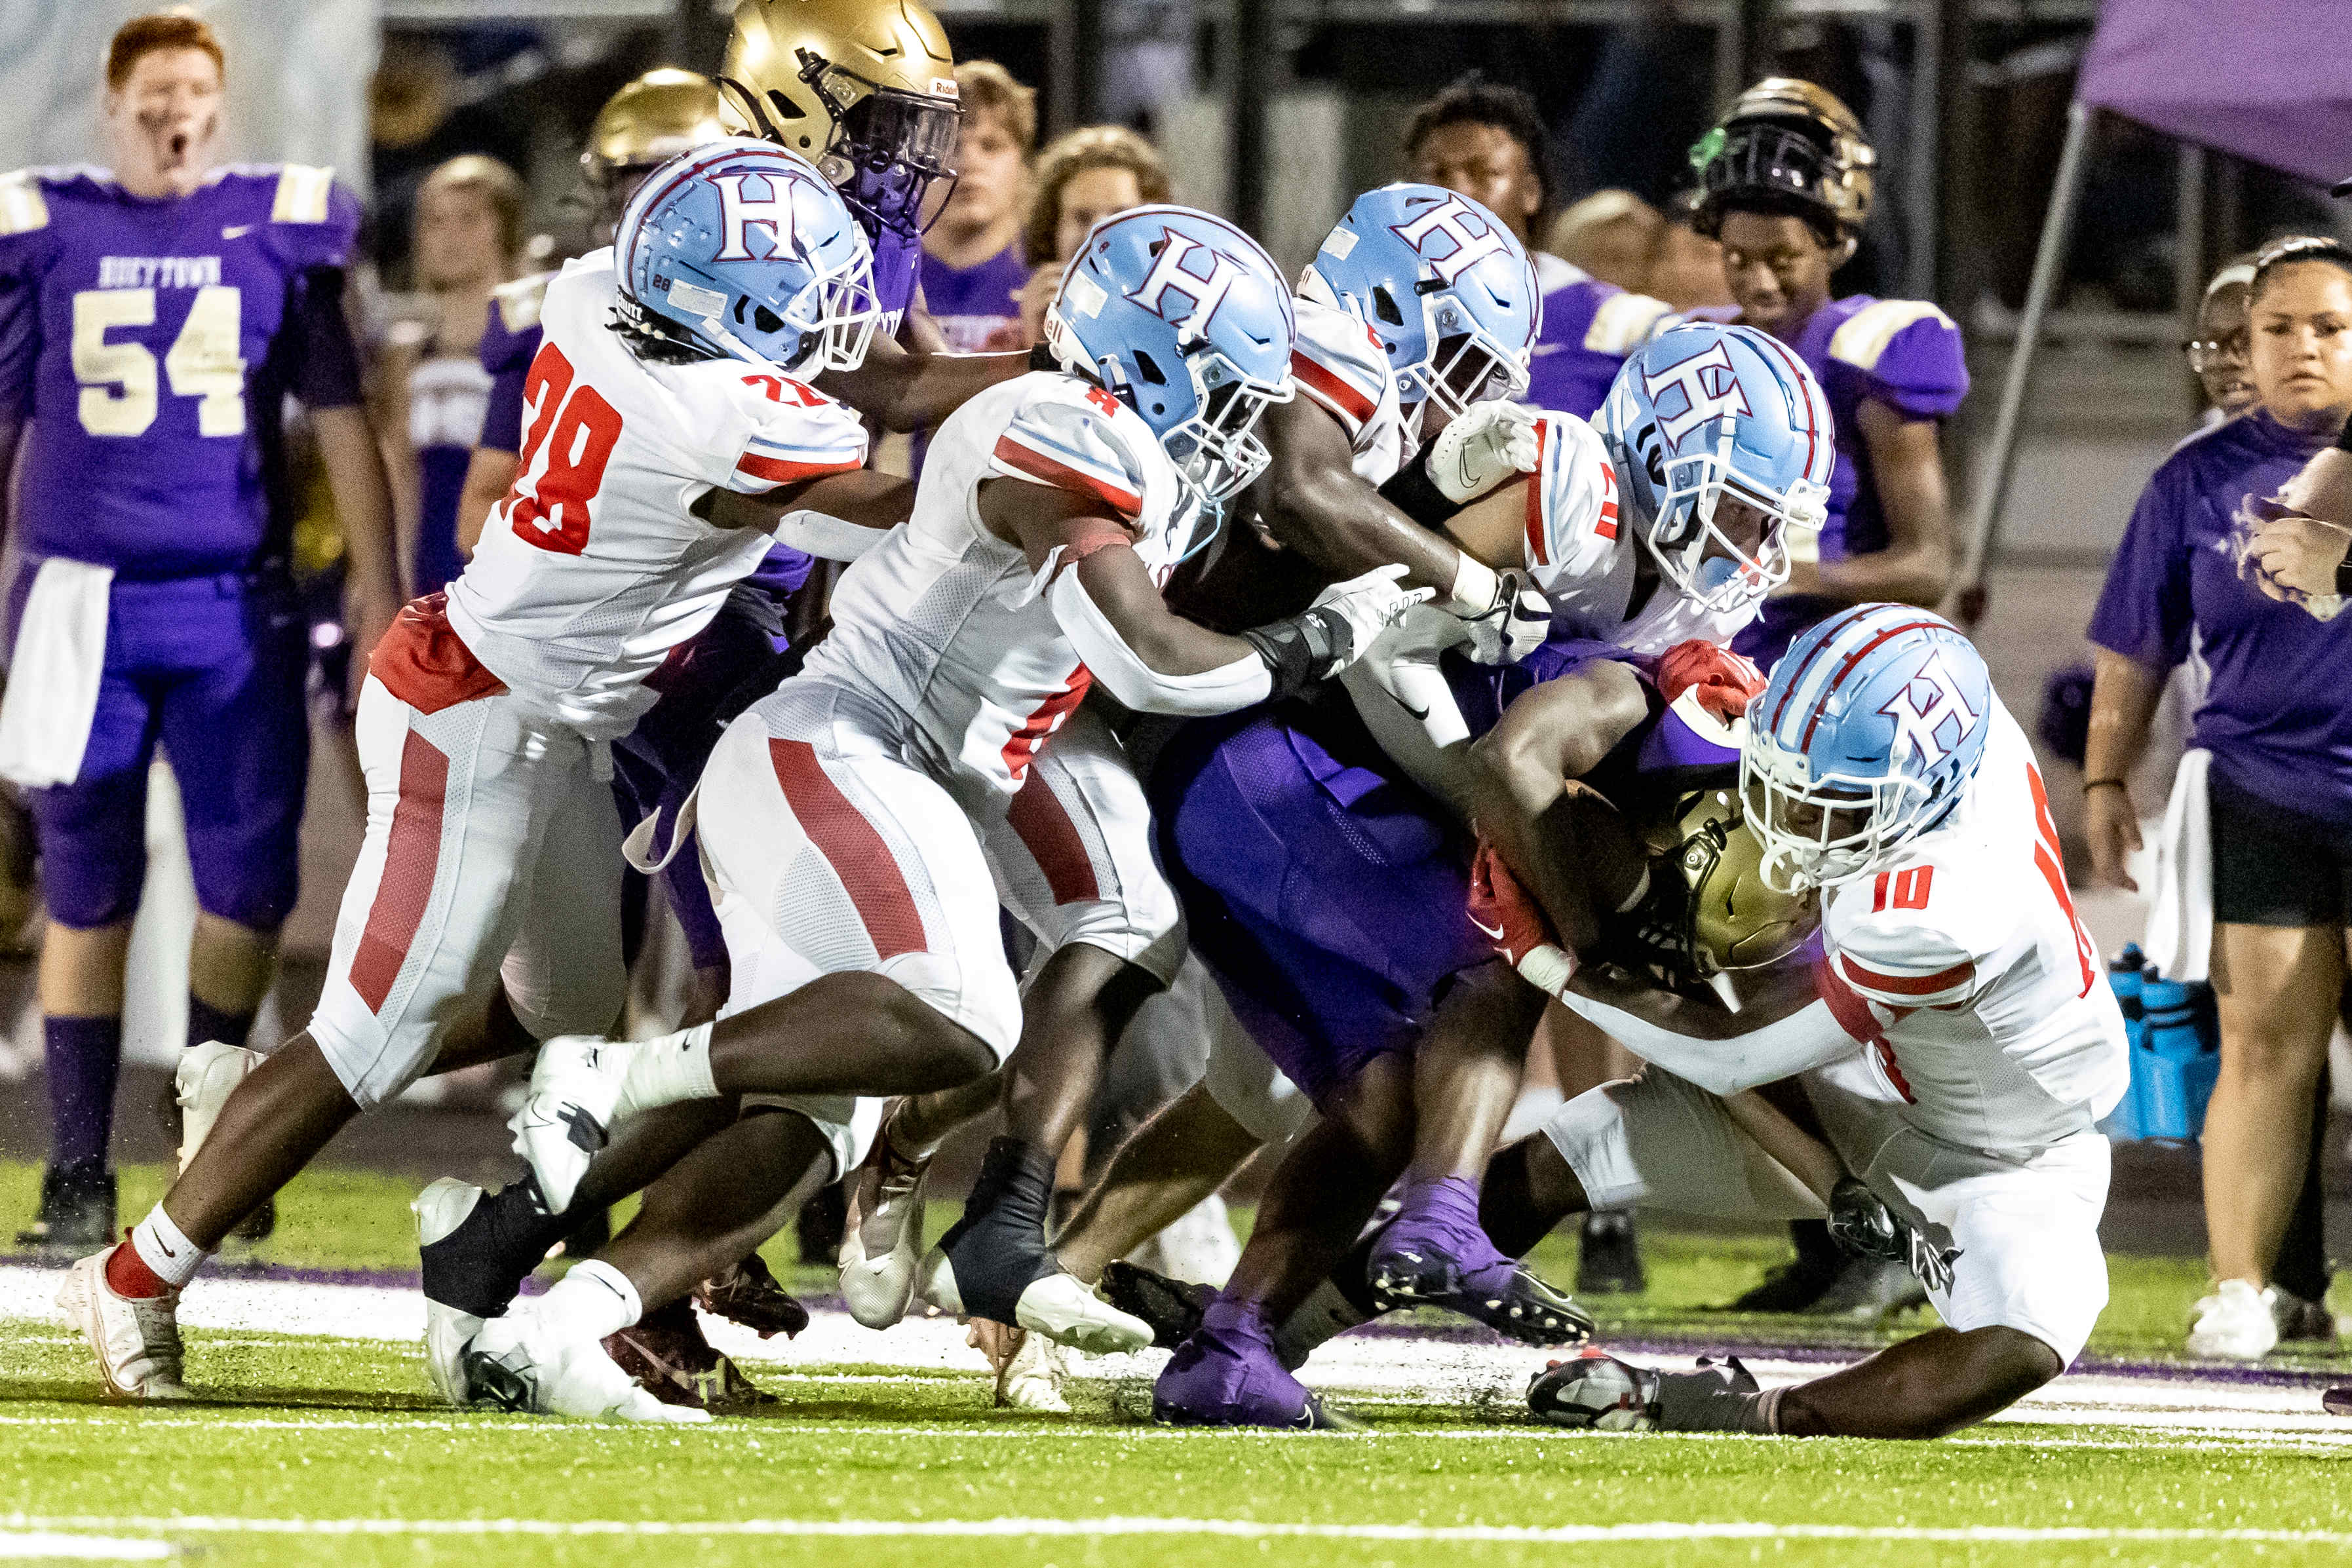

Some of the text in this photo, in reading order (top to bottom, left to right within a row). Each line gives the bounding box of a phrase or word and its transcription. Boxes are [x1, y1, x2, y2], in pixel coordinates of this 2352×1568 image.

[708, 172, 803, 263] H
[1389, 193, 1514, 288] H
[1123, 225, 1250, 338] H
[71, 284, 247, 438] 54
[1642, 339, 1754, 457] H
[500, 341, 623, 557] 28
[1876, 649, 1980, 780] H
[1871, 865, 1935, 914] 10
